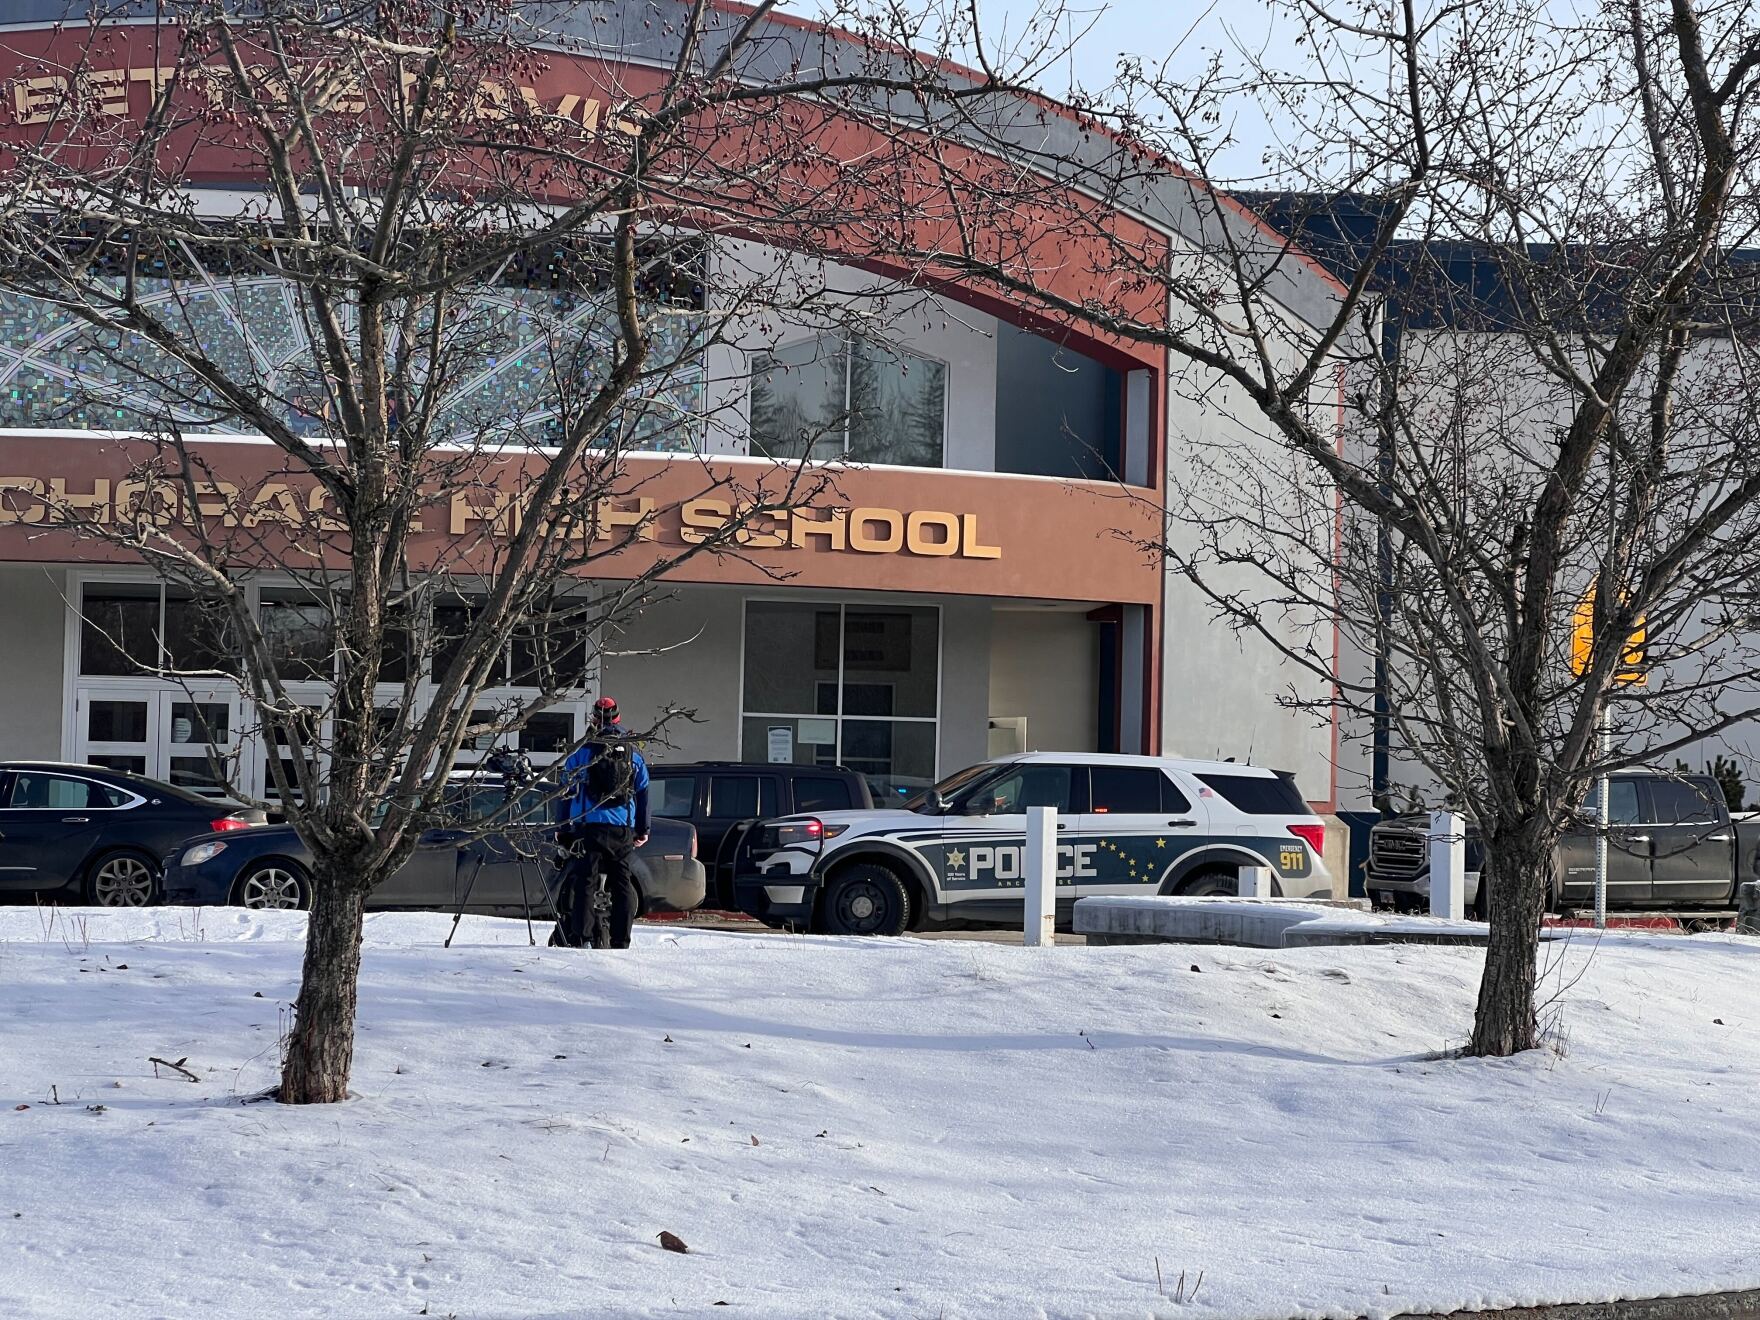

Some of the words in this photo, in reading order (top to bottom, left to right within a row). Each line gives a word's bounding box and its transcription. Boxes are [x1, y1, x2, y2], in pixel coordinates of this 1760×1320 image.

[681, 499, 1001, 558] SCHOOL
[970, 845, 1097, 880] POCE
[1281, 852, 1303, 870] 911
